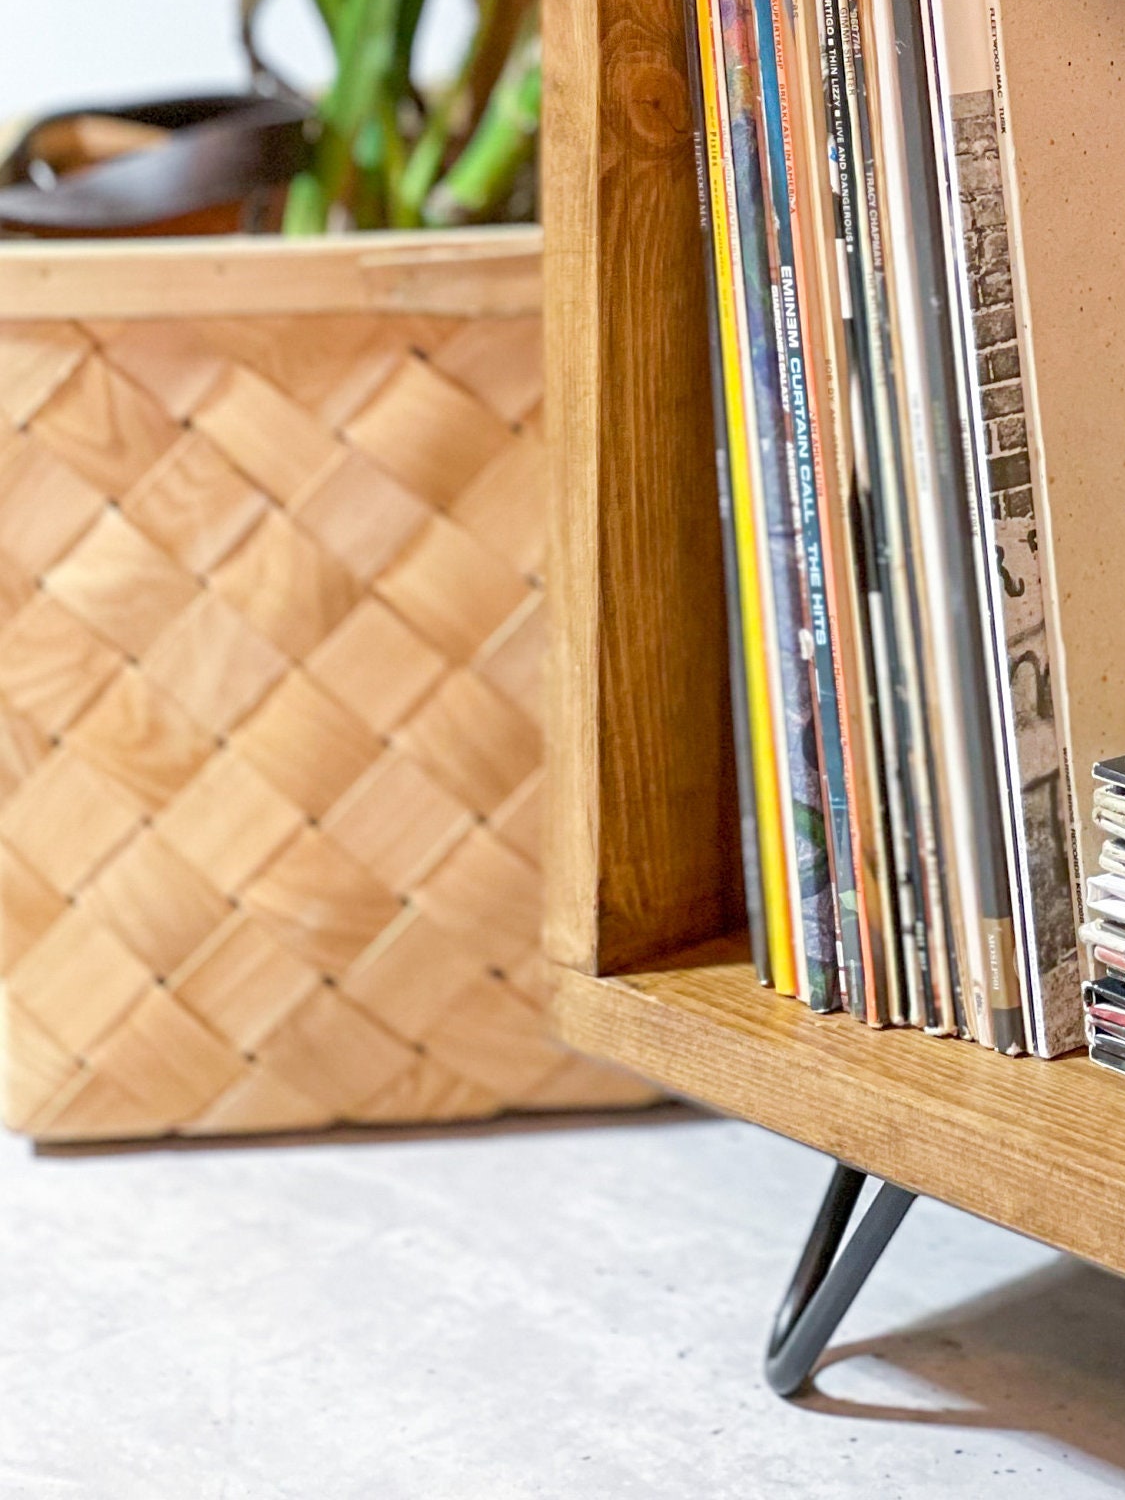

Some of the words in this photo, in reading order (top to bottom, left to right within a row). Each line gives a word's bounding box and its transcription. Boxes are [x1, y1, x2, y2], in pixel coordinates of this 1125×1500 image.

[990, 7, 1001, 72] FLEETWOOD
[830, 48, 840, 75] THIN
[832, 77, 842, 107] LIZZY
[996, 73, 1004, 98] MAC
[781, 82, 792, 145] BREAKFAST
[787, 149, 793, 161] IN
[836, 119, 846, 143] LIVE
[999, 105, 1007, 134] TUSK
[710, 130, 720, 167] Pixies
[838, 145, 848, 170] AND
[840, 172, 855, 242] DANGEROUS
[866, 171, 877, 207] TRACY
[870, 208, 883, 266] CHAPMAN
[825, 358, 833, 381] BOB
[790, 356, 810, 457] CURTAIN
[801, 463, 816, 523] CALL
[808, 542, 823, 587] THE
[813, 592, 828, 646] HITS
[1071, 828, 1081, 878] RECORDS
